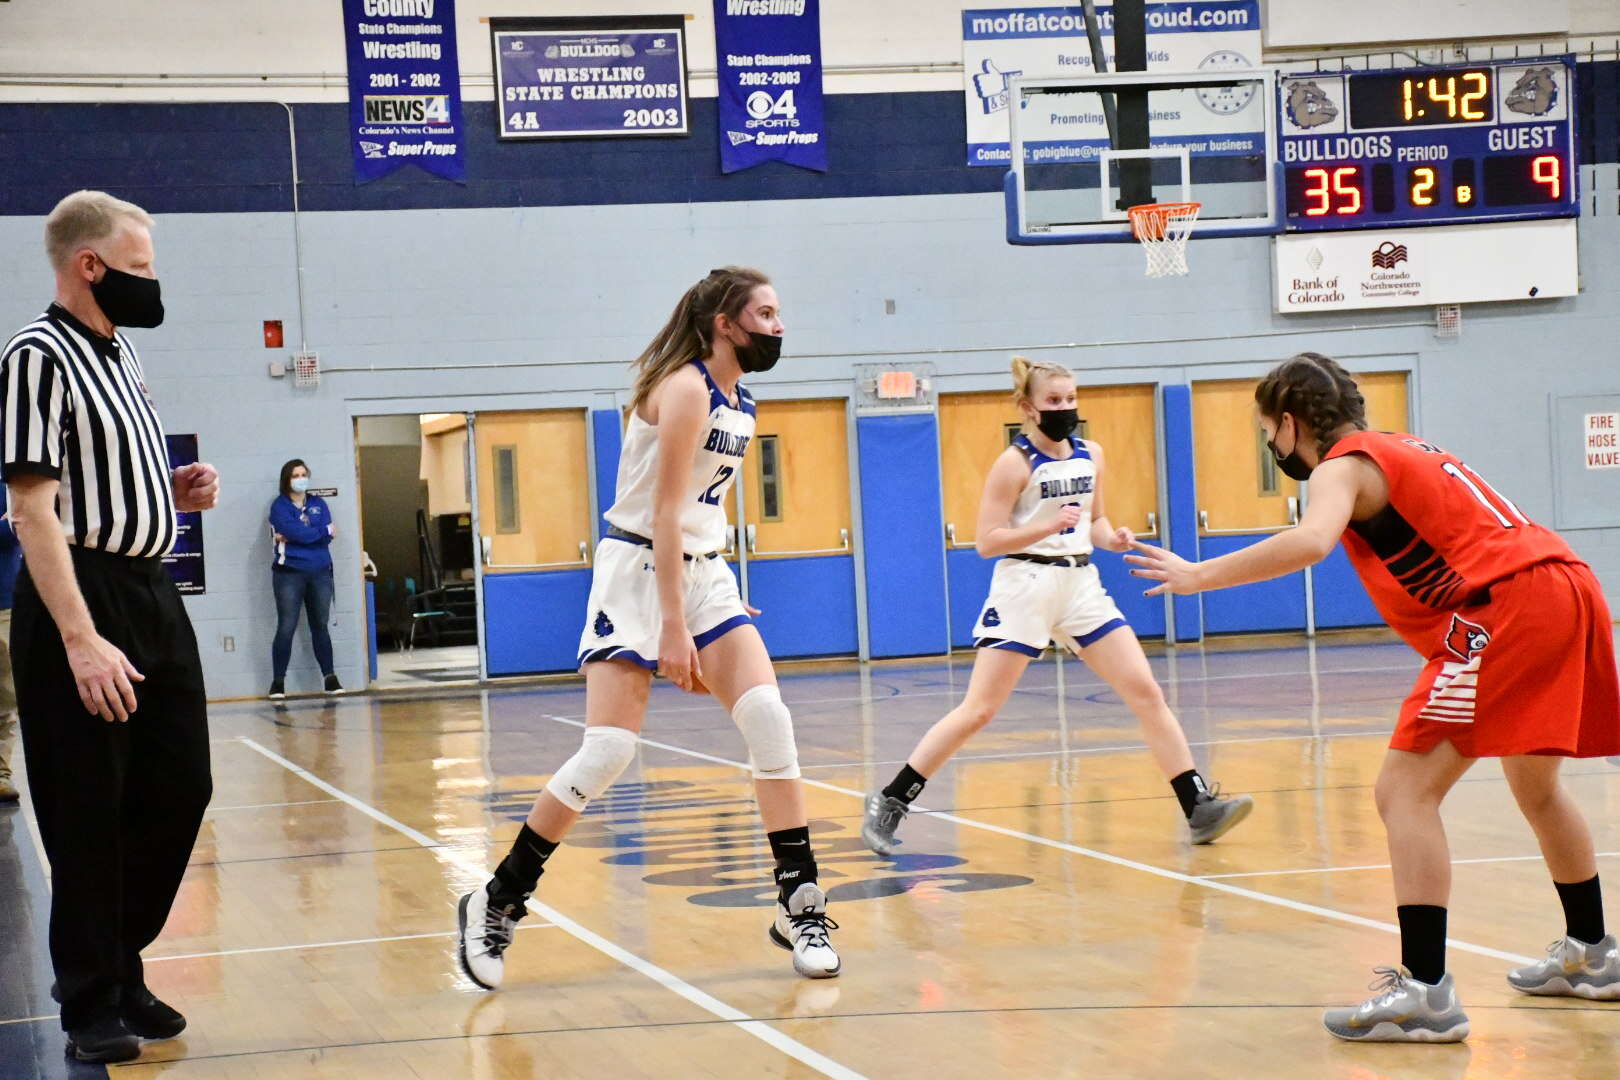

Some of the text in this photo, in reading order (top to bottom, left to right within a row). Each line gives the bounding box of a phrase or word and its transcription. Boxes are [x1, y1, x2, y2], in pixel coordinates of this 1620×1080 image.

[363, 0, 434, 18] County
[726, 0, 806, 16] Wrestling
[972, 7, 1249, 34] moffatcoutoud.com
[358, 23, 443, 35] State Champions
[363, 41, 441, 60] Wrestling
[560, 44, 621, 58] BULLDOG
[1147, 51, 1170, 62] Kids
[727, 53, 812, 66] State Champions
[369, 73, 399, 88] 2001
[410, 73, 441, 87] 2002
[537, 66, 646, 83] WRESTLING
[739, 71, 800, 86] 2002-2003
[505, 83, 678, 101] STATE CHAMPIONS
[1402, 72, 1488, 120] 1:42
[773, 89, 797, 119] 4
[508, 108, 679, 130] 4A 2003
[745, 119, 800, 129] SPORTS
[1050, 112, 1104, 126] Promoting
[358, 125, 455, 136] Colorado's News Channel
[1209, 139, 1254, 151] business
[1284, 126, 1557, 163] BULLDOGS PERIOD GUEST
[1304, 166, 1361, 217] 35
[1411, 167, 1435, 206] 2
[1532, 155, 1561, 199] 9
[1292, 276, 1339, 290] Bank of
[1370, 271, 1411, 281] Colorado
[1361, 281, 1421, 290] Northwestern
[1288, 290, 1345, 304] Colorado
[1590, 415, 1614, 429] FIRE
[1588, 434, 1617, 448] HOSE
[1587, 451, 1620, 466] VALVE
[697, 464, 734, 506] 12
